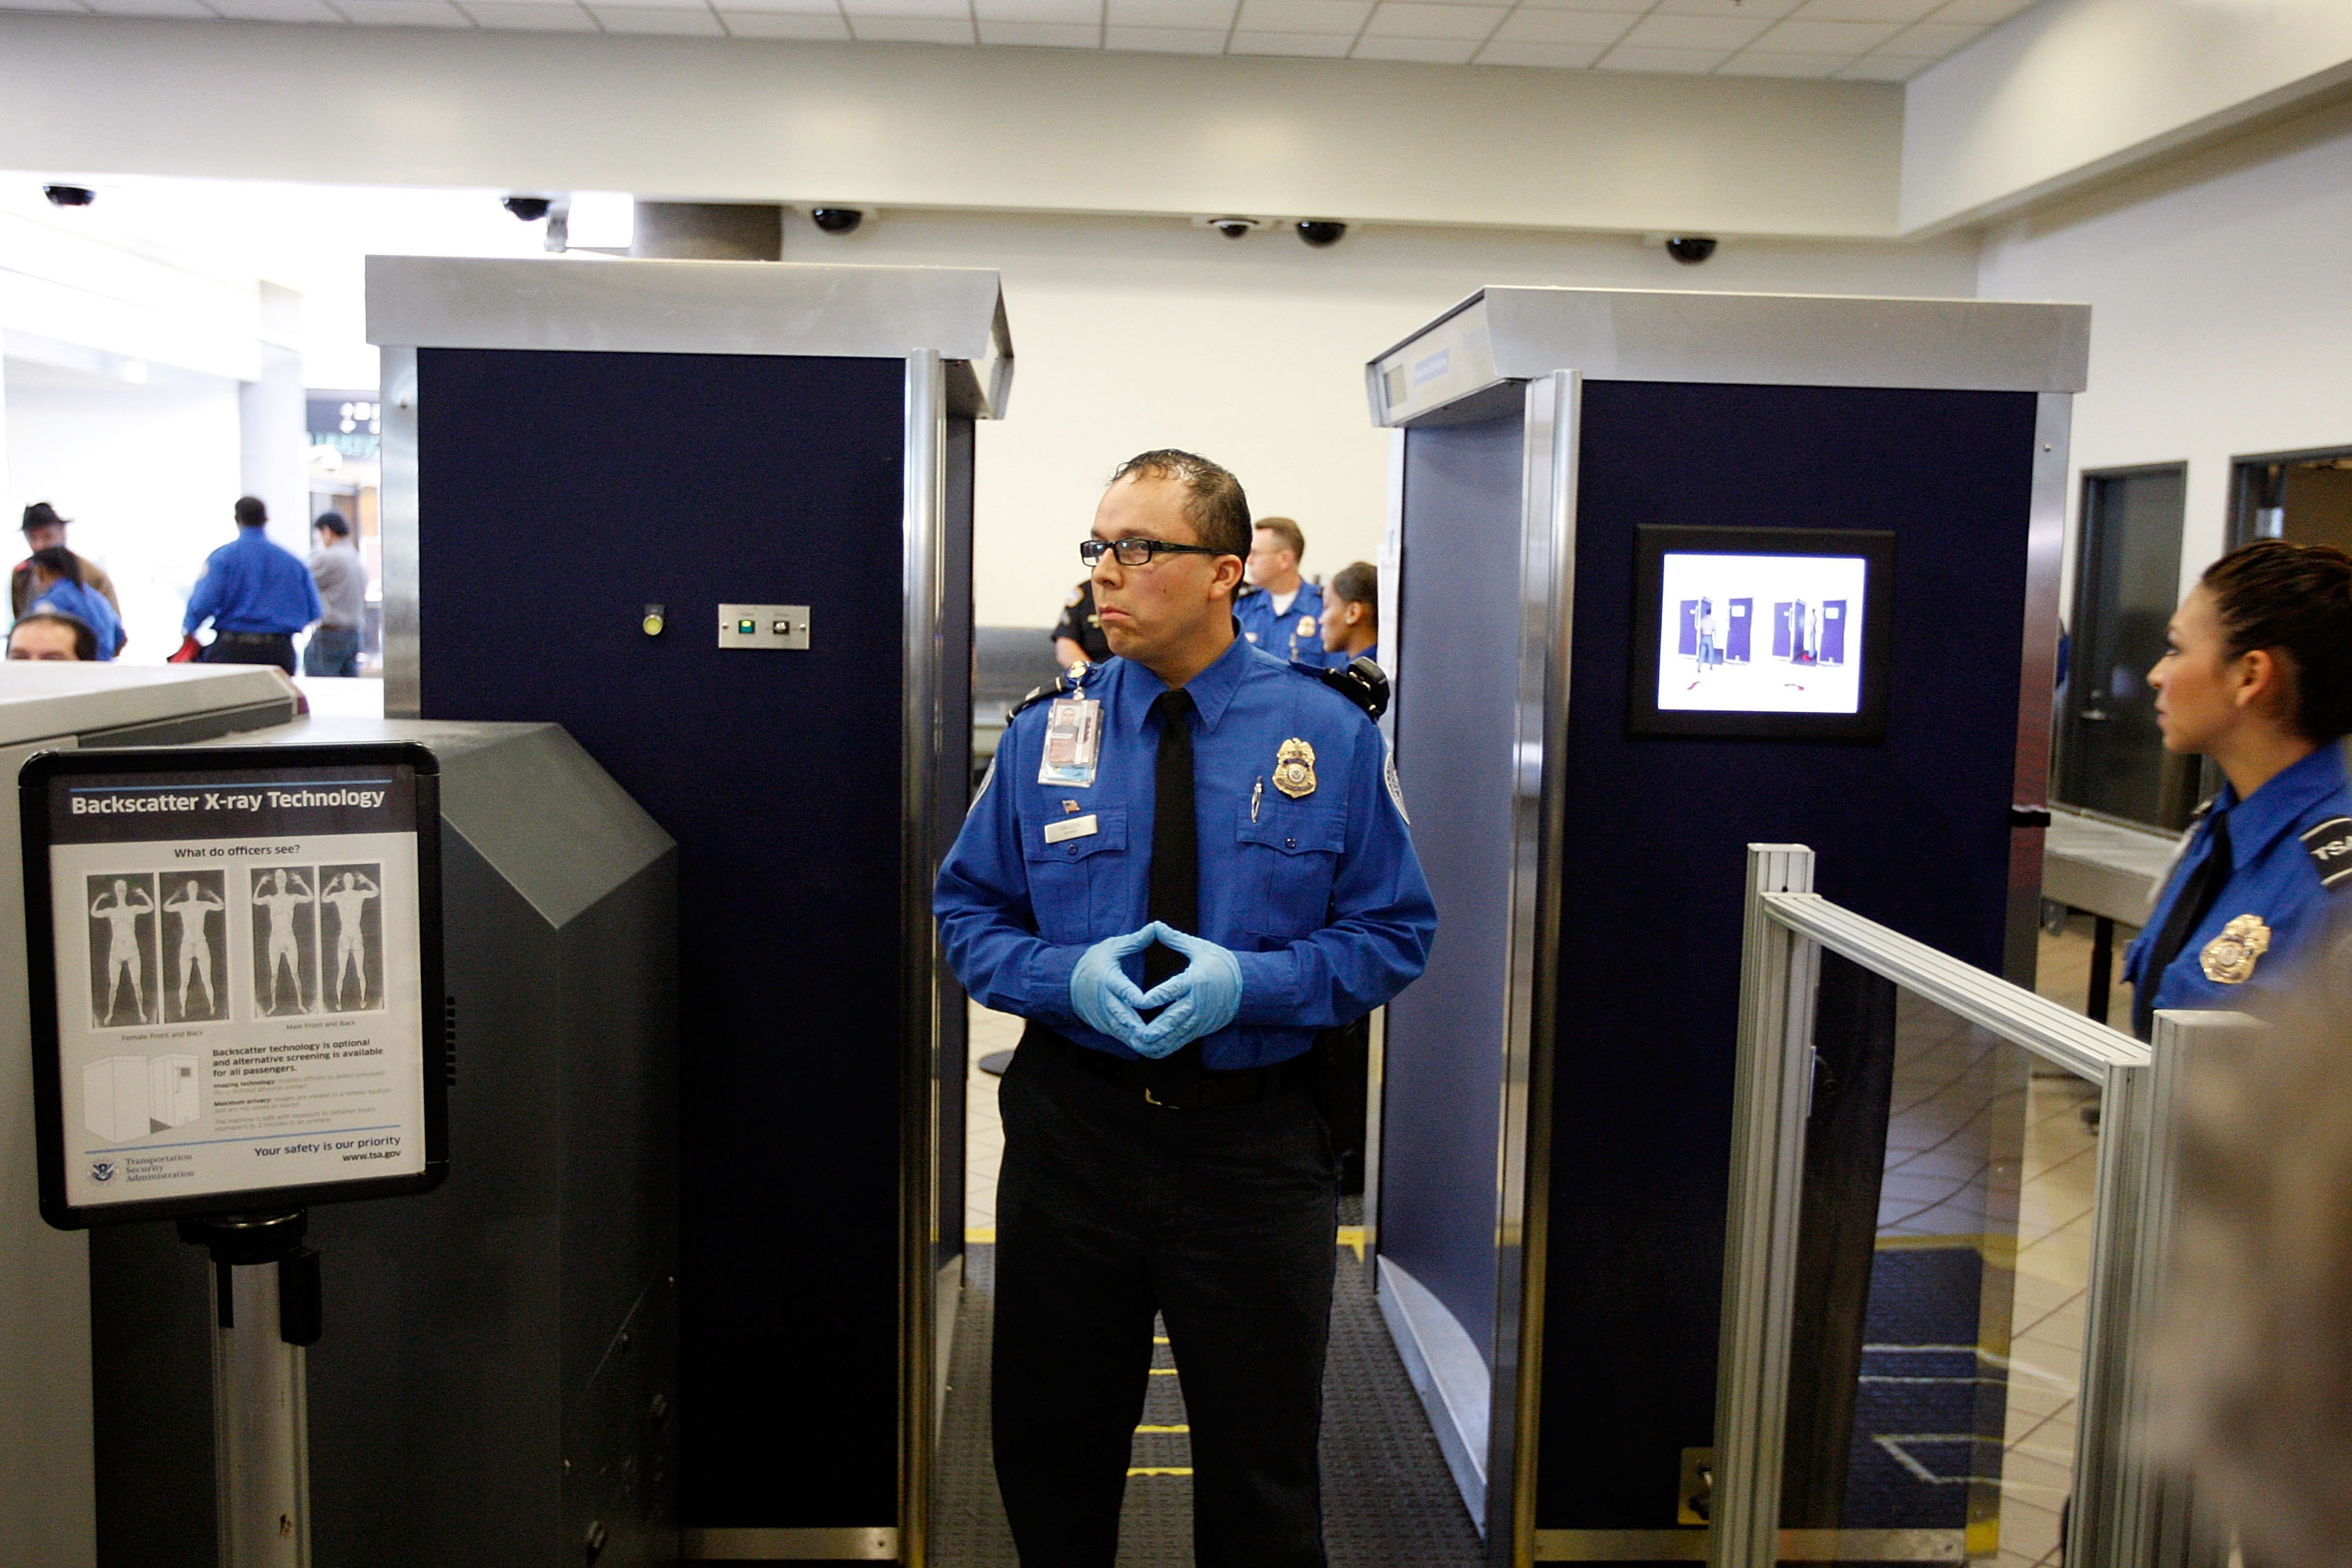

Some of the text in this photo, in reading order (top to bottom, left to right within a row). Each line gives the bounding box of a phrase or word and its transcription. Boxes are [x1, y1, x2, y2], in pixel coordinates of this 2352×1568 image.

[72, 789, 385, 815] Backscatter X-ray Technology
[174, 844, 301, 858] What do officers see?
[212, 1047, 267, 1056] Backscatter
[270, 1043, 320, 1052] technology
[332, 1039, 370, 1048] optional
[233, 1055, 284, 1065] alternative
[287, 1052, 330, 1062] screening
[343, 1047, 383, 1057] available
[243, 1065, 297, 1076] passengers.
[255, 1147, 281, 1156] Your
[285, 1143, 320, 1154] safety
[324, 1142, 332, 1150] is
[358, 1136, 401, 1149] priority
[125, 1154, 193, 1164] Transportation
[343, 1150, 401, 1161] www.tsa.gov
[125, 1170, 194, 1181] Administration
